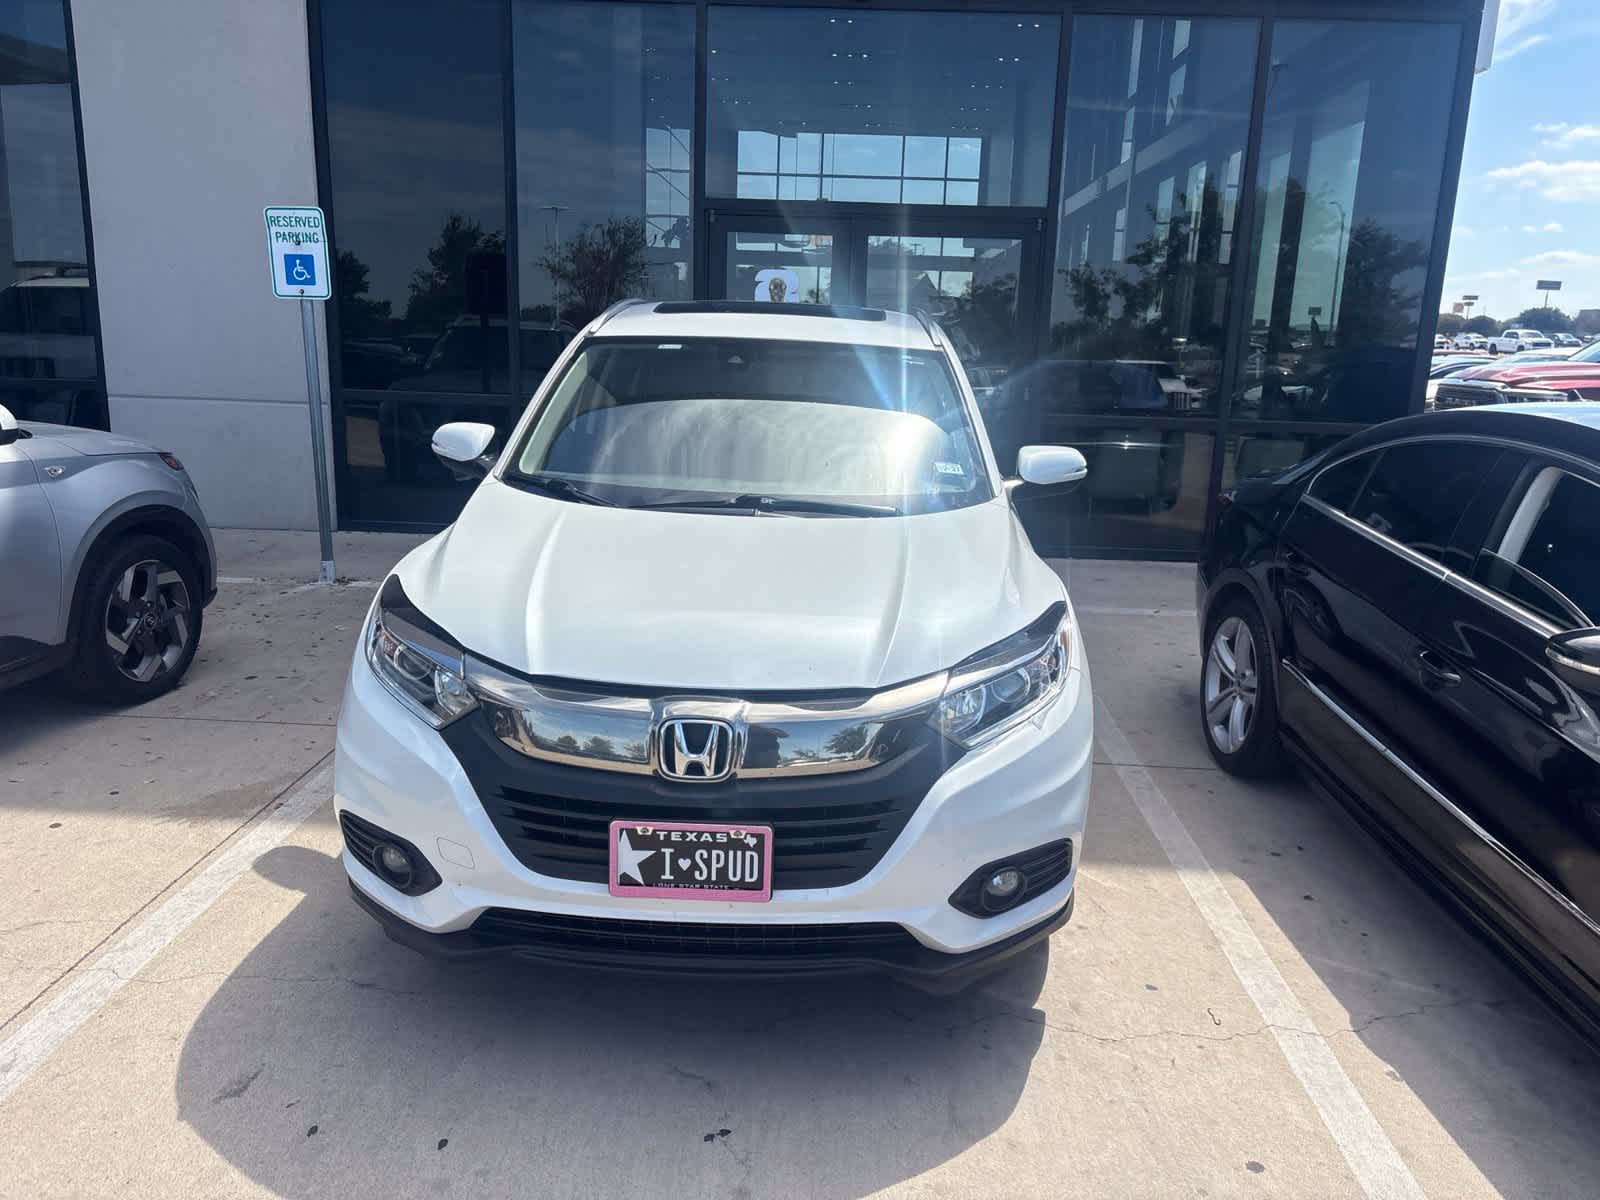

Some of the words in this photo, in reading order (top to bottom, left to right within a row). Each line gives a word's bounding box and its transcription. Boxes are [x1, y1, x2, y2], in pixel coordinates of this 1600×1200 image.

[269, 215, 320, 228] RESERVED
[275, 231, 320, 244] PARKING
[656, 831, 728, 843] TEXAS
[694, 850, 759, 882] SPUD
